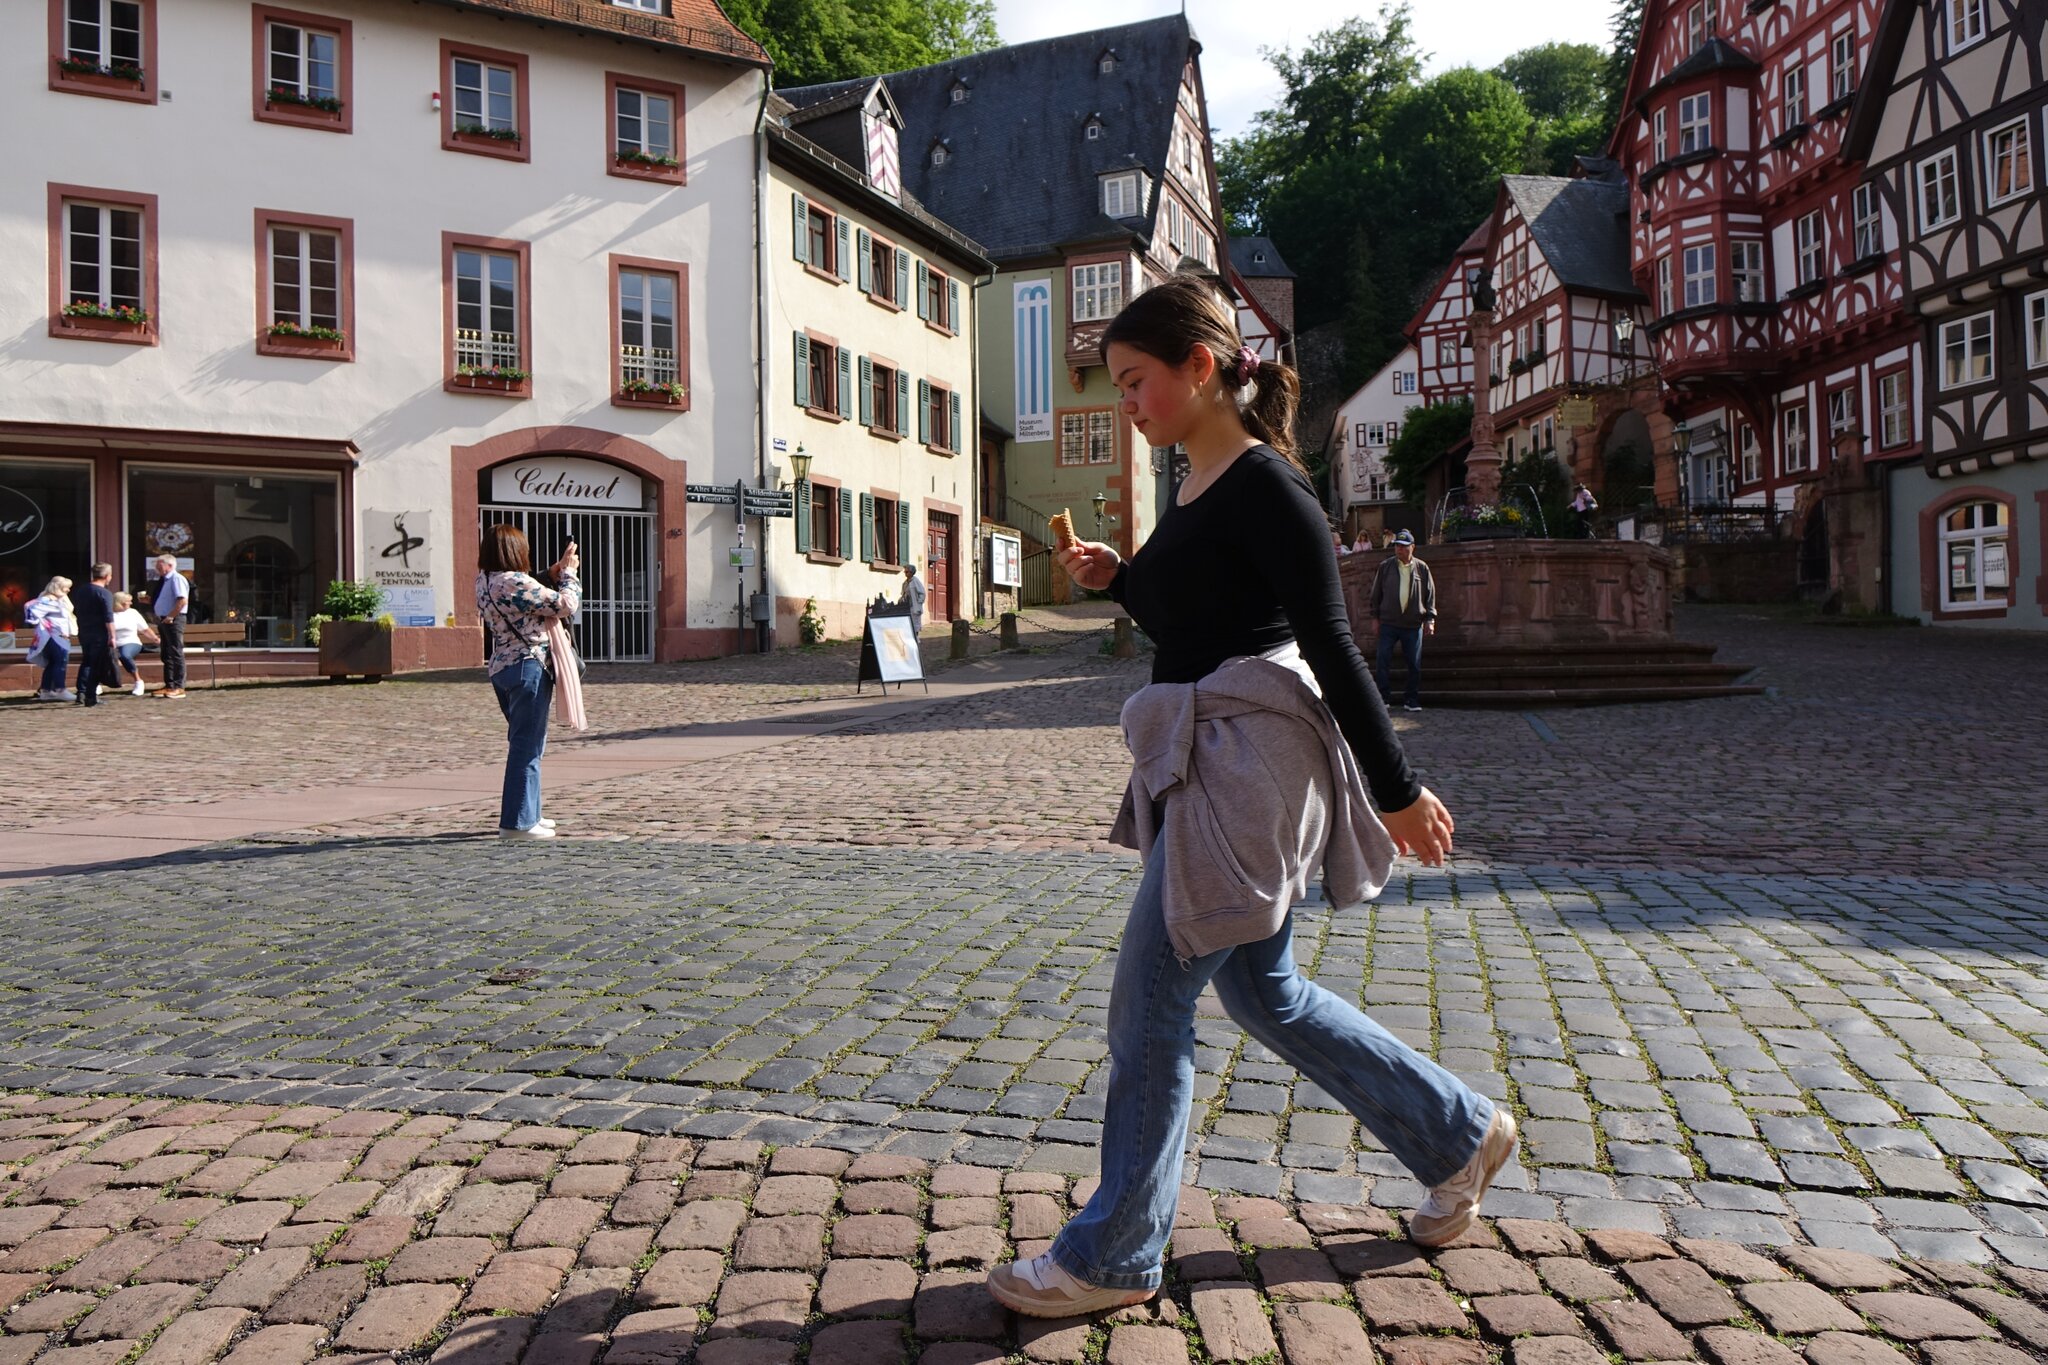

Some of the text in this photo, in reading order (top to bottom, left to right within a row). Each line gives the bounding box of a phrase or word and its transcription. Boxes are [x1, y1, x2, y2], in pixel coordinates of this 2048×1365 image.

[514, 467, 621, 499] Cabinet
[712, 486, 736, 494] Rathaus
[749, 489, 783, 498] Mildenburg
[702, 495, 721, 503] Tourist
